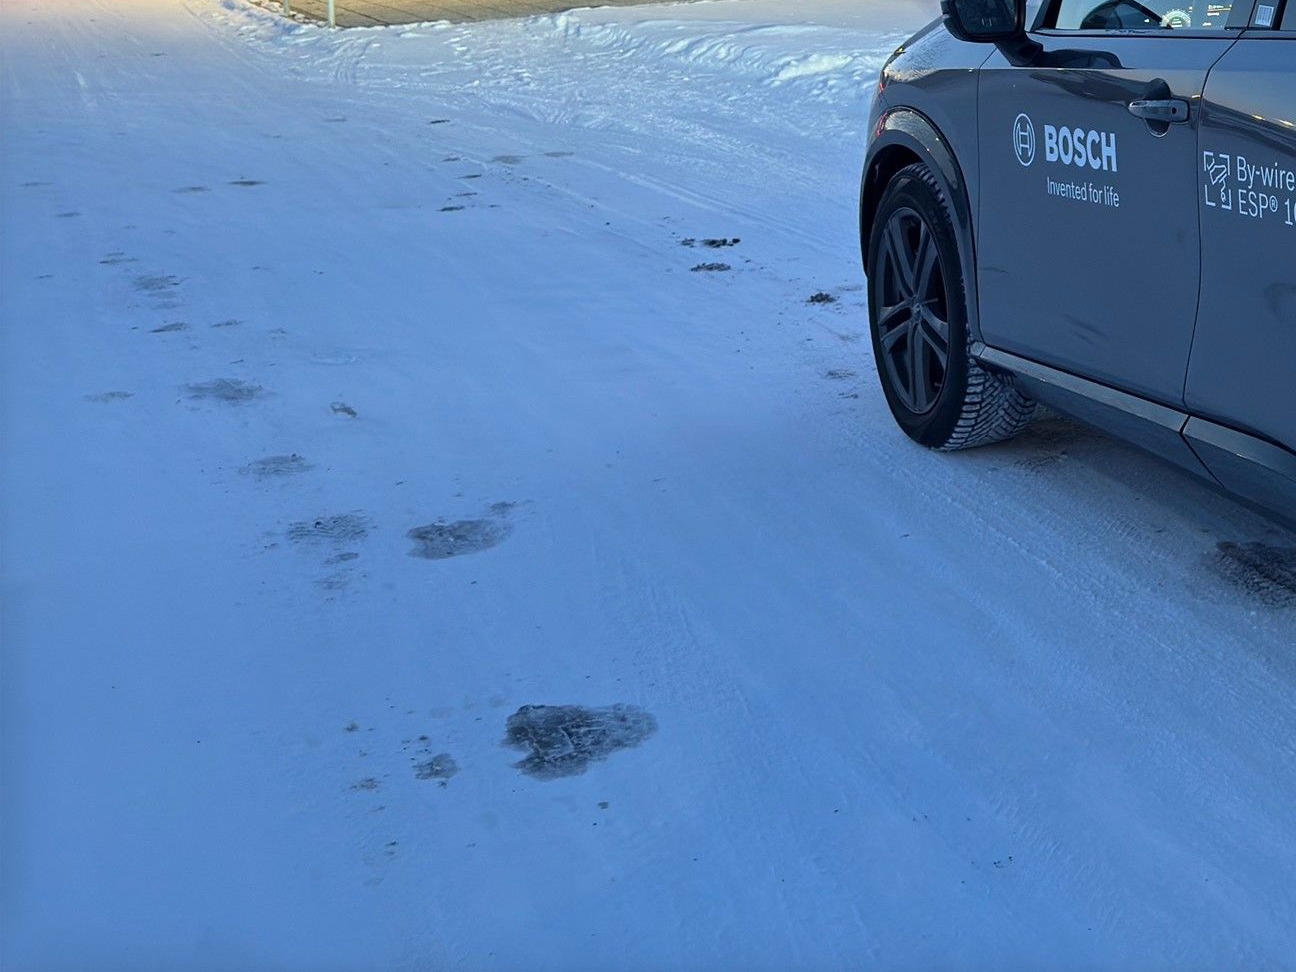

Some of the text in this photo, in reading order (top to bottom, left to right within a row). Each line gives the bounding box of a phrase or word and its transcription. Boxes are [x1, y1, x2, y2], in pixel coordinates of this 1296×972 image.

[1044, 124, 1118, 172] BOSCH
[1236, 155, 1295, 191] By-wire
[1046, 176, 1120, 207] Invented for life
